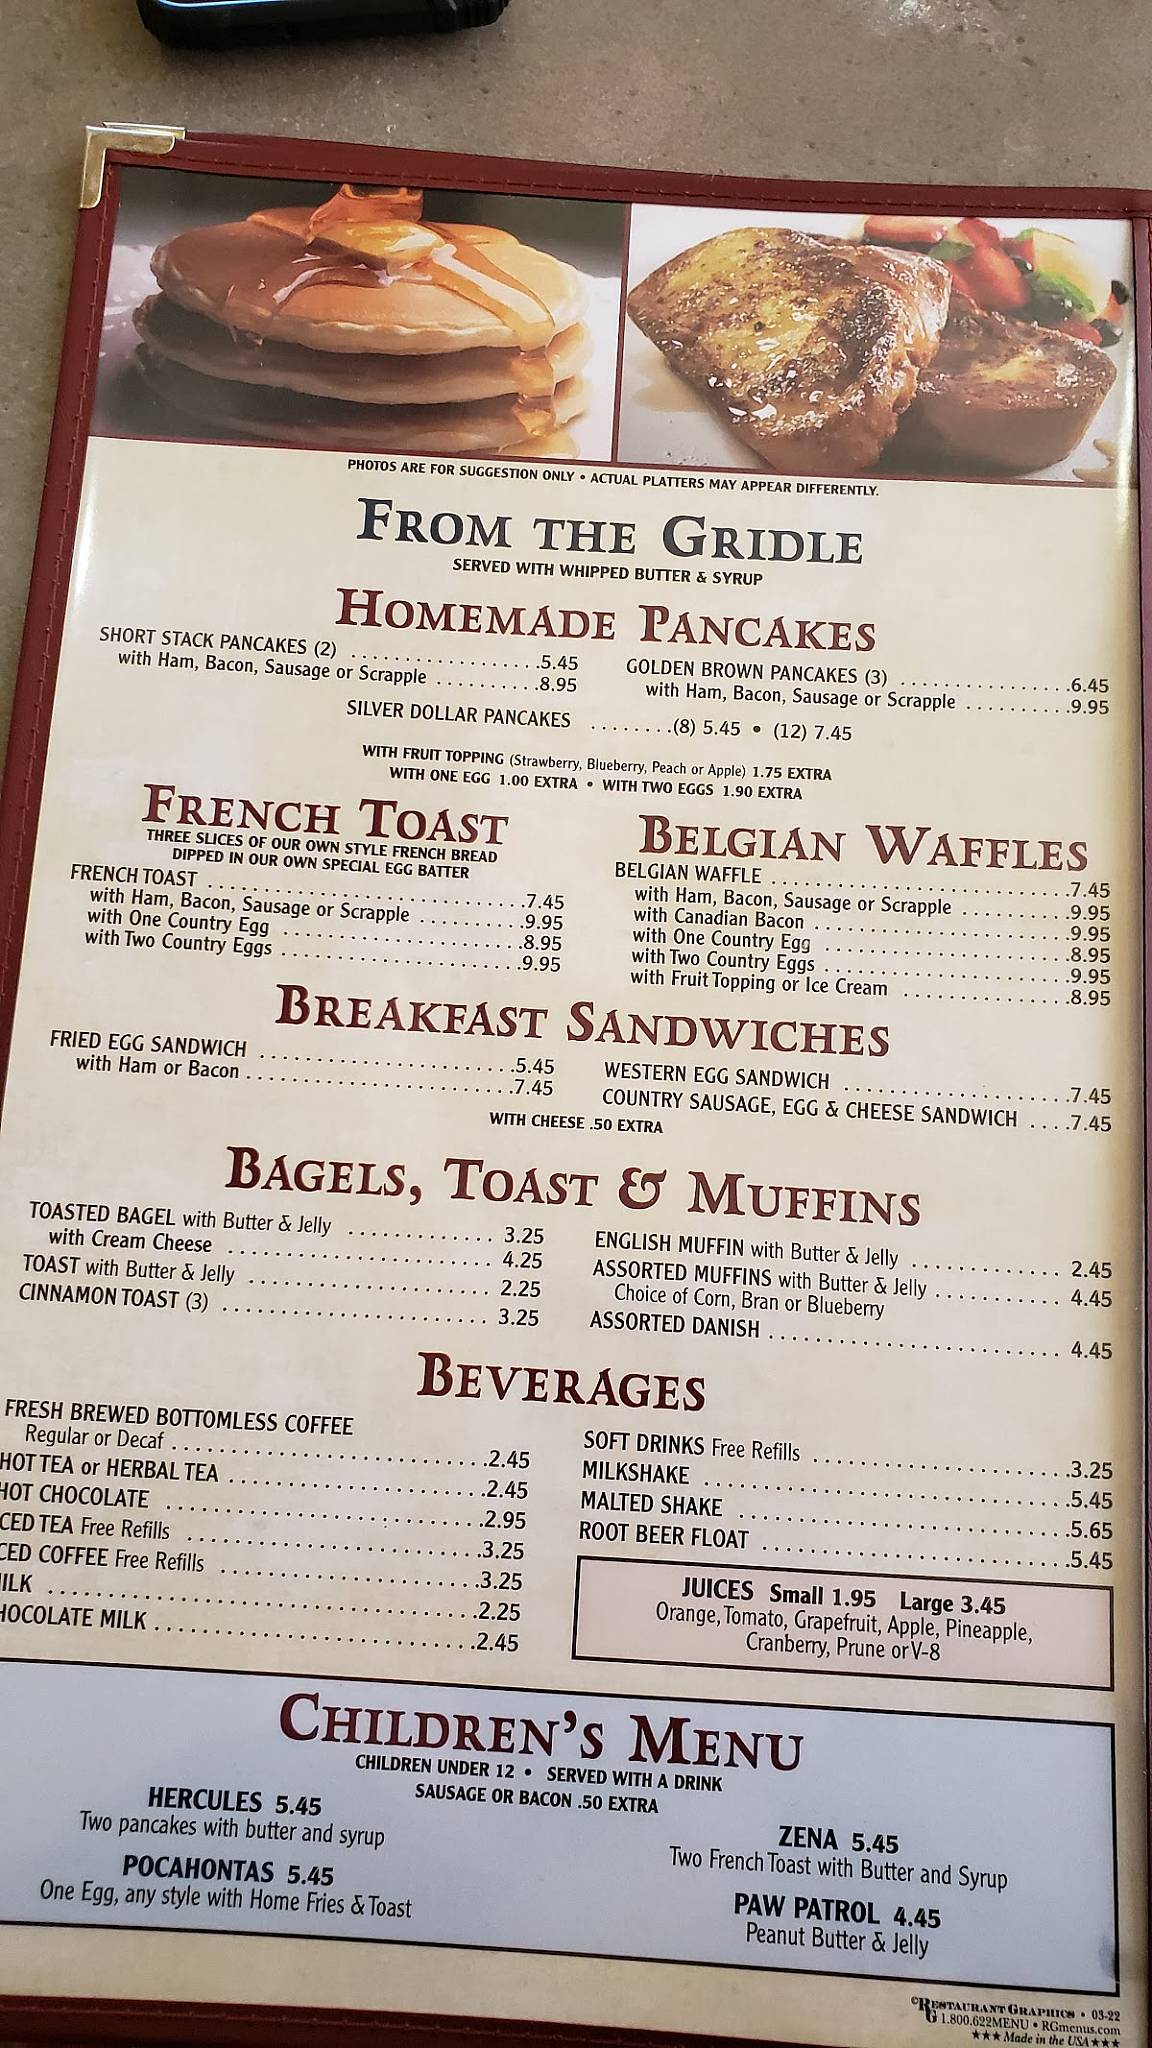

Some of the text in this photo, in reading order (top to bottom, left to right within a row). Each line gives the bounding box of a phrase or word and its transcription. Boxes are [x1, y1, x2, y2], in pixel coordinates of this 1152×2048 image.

[347, 459, 879, 496] PHOTOS ARE FOR SUGGESTION ONLY ACTUAL PLATTERS MAY APPEAR DIFFERENTLY.
[533, 518, 636, 554] THE
[452, 558, 763, 586] SERVED WITH WHIPPED BUTTER & SYRUP
[99, 626, 578, 671] SHORT STACK PANCAKES (2) 5.45
[346, 699, 852, 742] SILVER DOLLAR PANCAKES (8) 5.45 (12) 7.45
[362, 744, 832, 781] WITH FRUIT TOPPING (Strawberry, Blueberry, Peach or Apple) 1.75 EXTRA
[146, 828, 498, 863] THREE SLICES OF OUR OWN STYLE FRENCH BREAD
[615, 861, 1110, 898] BELGIAN WAFFLE 7.45
[90, 887, 563, 931] with Ham, Bacon, Sausage or Scrapple 9.95
[633, 906, 1111, 942] with Canadian Bacon 9.95
[630, 969, 1111, 1006] with Fruit Topping or Ice Cream 8.95
[50, 1029, 555, 1075] FRIED EGG SANDWICH 5.45
[602, 1088, 1112, 1132] COUNTRY SAUSAGE, EGG & CHEESE SANDWICH 7.45
[618, 1167, 667, 1210] &
[595, 1230, 1112, 1279] ENGLISH MUFFIN with Butter & Jelly 2.45
[19, 1282, 539, 1327] CINNAMON TOAST (3) 3.25
[614, 1283, 885, 1321] Choice of Corn, Bran or Blueberry
[5, 1398, 354, 1436] FRESH BREWED BOTTOMLESS COFFEE
[583, 1430, 1113, 1480] SOFT DRINKS Free Refills 3.25
[582, 1460, 1113, 1510] MILKSHAKE 5.45
[681, 1577, 1006, 1616] JUICES Small 1.95 Large 3.45
[148, 1786, 322, 1817] HERCULES 5.45
[415, 1783, 659, 1814] SAUSAGE OR BACON .50 EXTRA
[79, 1810, 385, 1851] Two pancakes with butter and syrup
[778, 1825, 899, 1854] ZENA 5.45
[941, 2013, 1121, 2036] 1.800.622MENU RGmenus.com
[1091, 2009, 1121, 2022] 03-22
[1003, 2031, 1090, 2047] Made in the USA
